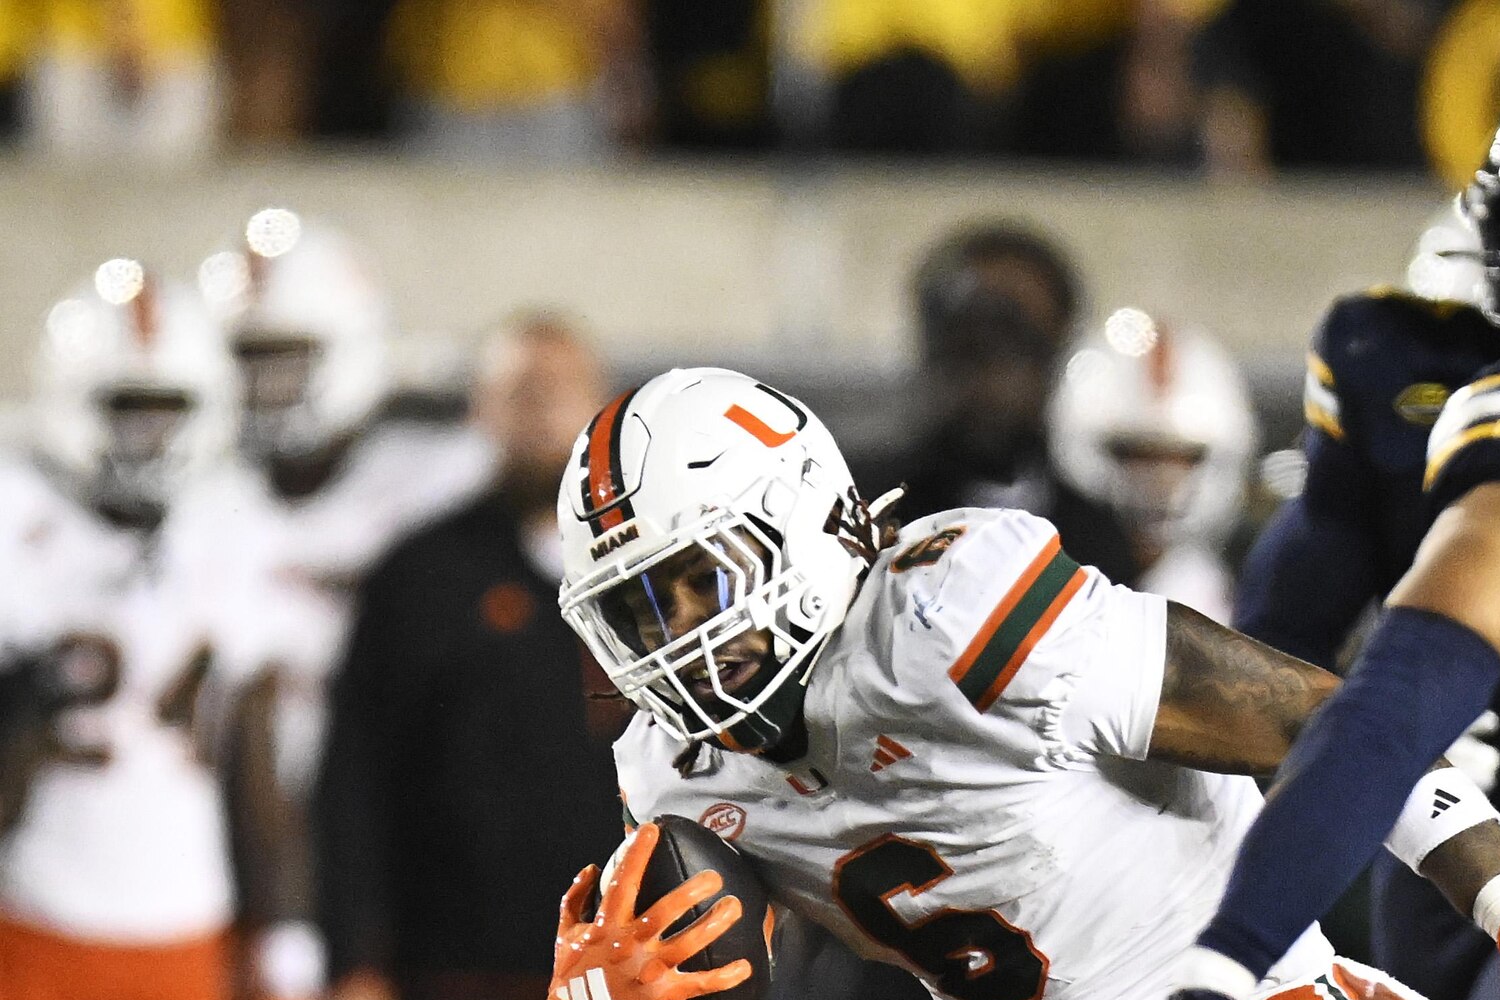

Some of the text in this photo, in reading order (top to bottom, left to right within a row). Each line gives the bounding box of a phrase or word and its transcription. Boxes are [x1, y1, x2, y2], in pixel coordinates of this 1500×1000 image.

[723, 383, 808, 448] U
[590, 524, 640, 562] MIAMI
[785, 766, 830, 796] U
